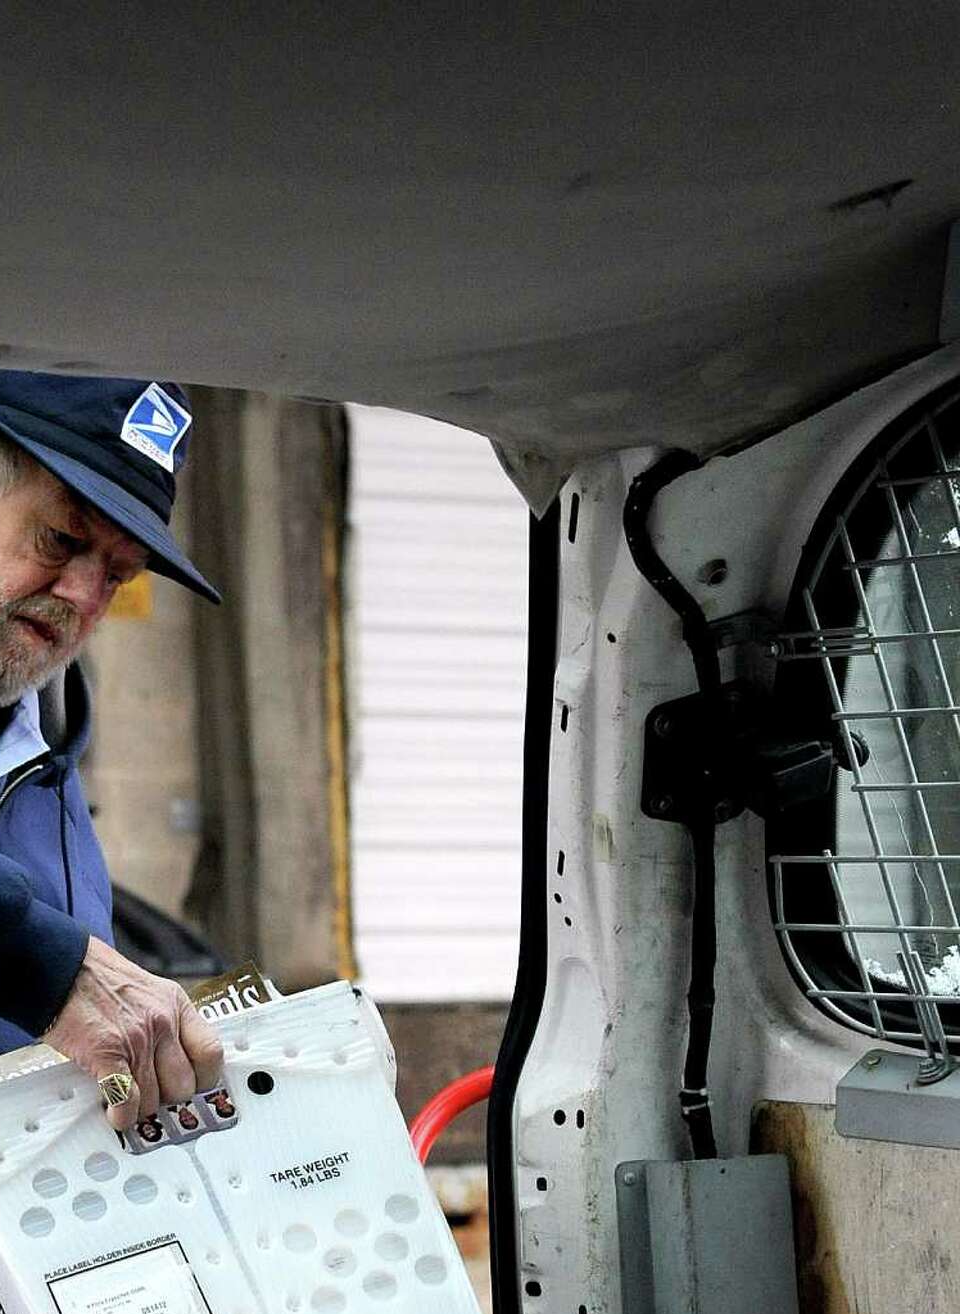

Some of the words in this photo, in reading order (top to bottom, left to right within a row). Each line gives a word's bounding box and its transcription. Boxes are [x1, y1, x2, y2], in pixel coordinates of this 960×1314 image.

[270, 1166, 303, 1184] TARE
[303, 1152, 350, 1174] WEIGHT
[291, 1175, 315, 1190] 1.84
[316, 1167, 341, 1183] LBS
[44, 1267, 68, 1281] PLACE
[68, 1260, 92, 1273] LABEL
[93, 1249, 123, 1264] HOLDER
[123, 1241, 146, 1254] INSIDE
[146, 1232, 177, 1248] BORDER
